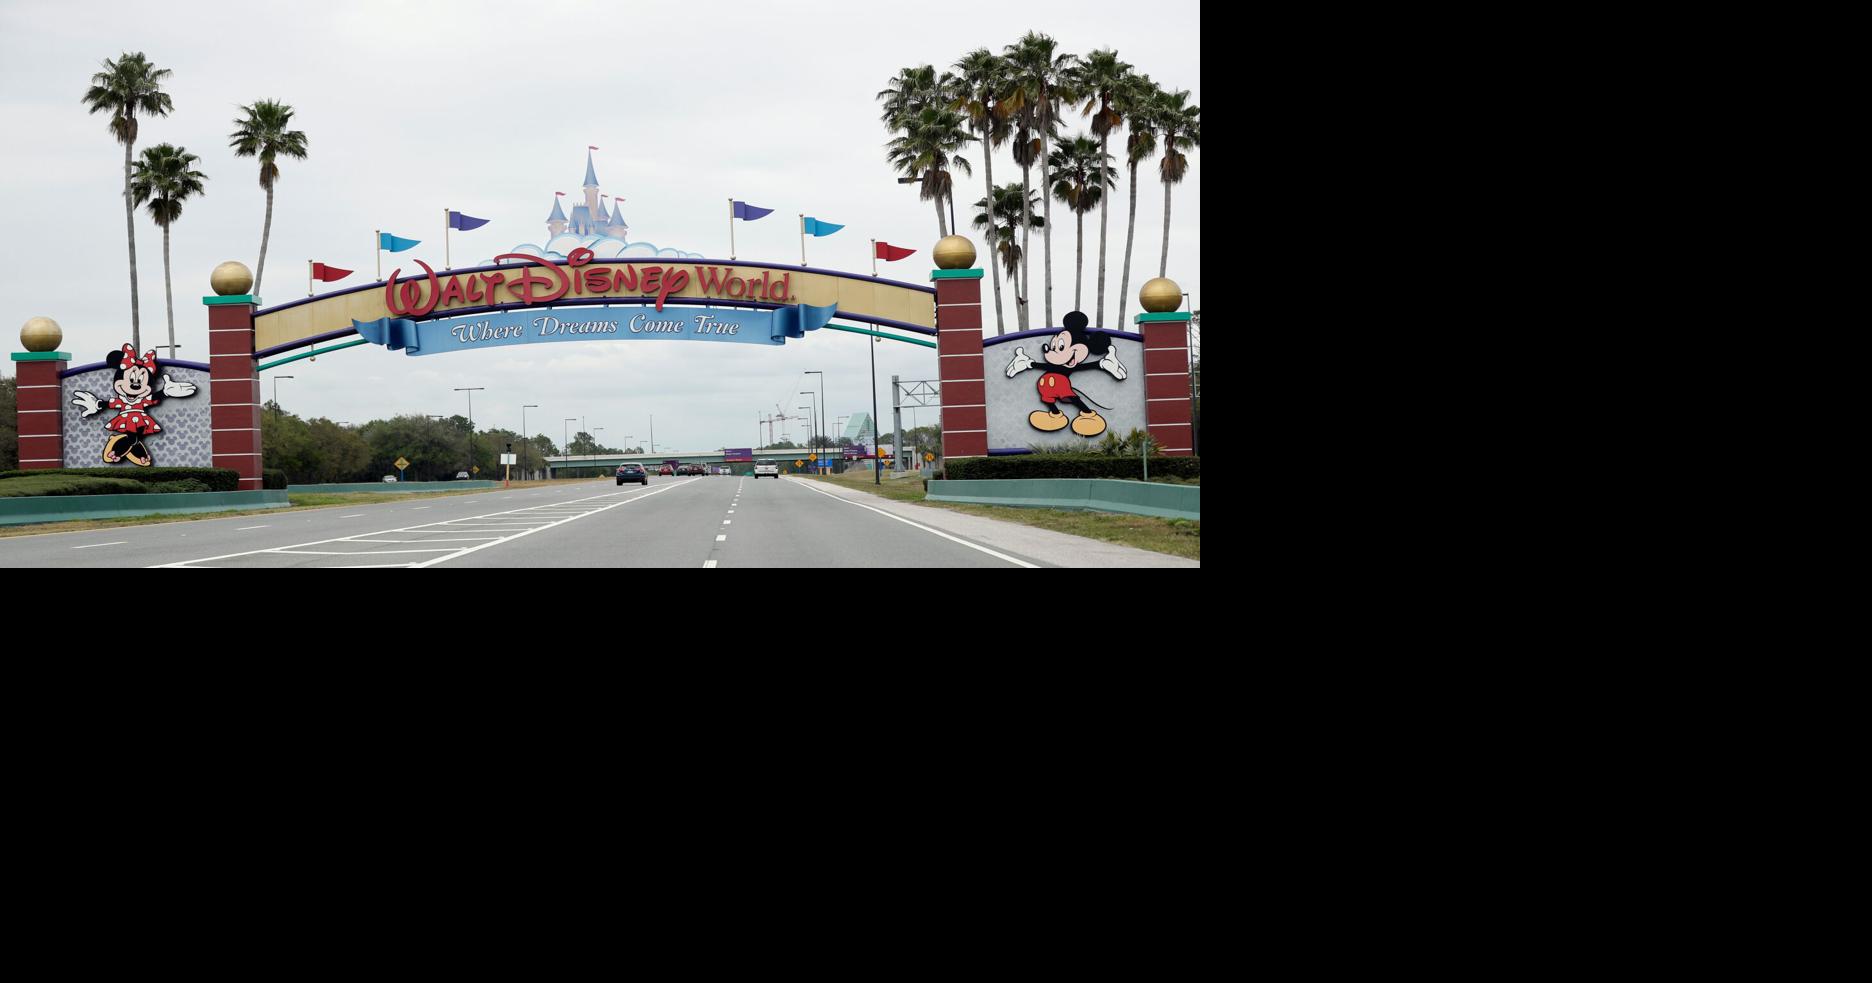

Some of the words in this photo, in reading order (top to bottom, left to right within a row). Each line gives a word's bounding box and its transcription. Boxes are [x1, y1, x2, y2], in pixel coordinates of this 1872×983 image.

[452, 320, 523, 344] Where
[532, 316, 618, 337] Dreams
[629, 313, 684, 333] Come
[694, 314, 740, 335] True
